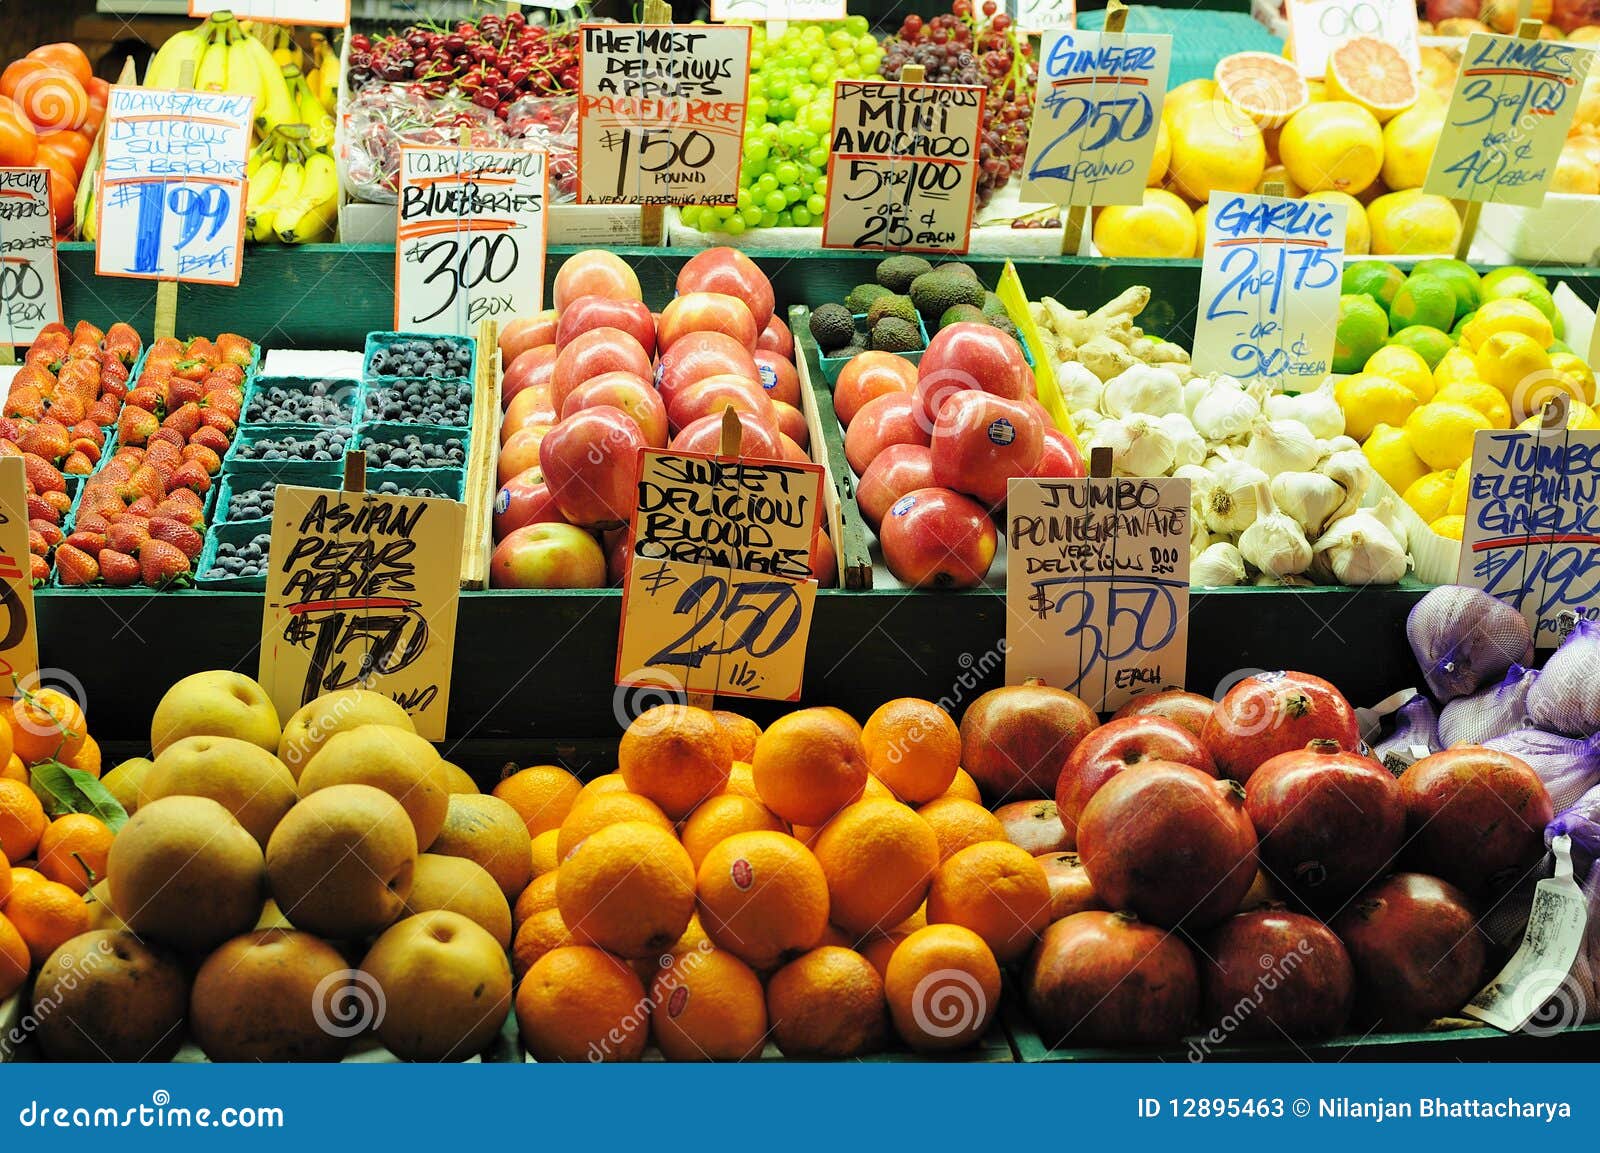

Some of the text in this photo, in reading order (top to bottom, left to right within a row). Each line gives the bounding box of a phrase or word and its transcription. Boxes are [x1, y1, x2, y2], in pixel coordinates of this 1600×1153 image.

[582, 28, 707, 54] THE MOST
[1046, 35, 1156, 77] GINGER
[1472, 38, 1576, 74] LIMES
[598, 78, 722, 98] APPLES
[836, 84, 977, 107] DELICIOUS
[1451, 79, 1498, 126] 3
[582, 95, 682, 122] PACIFIC
[858, 99, 948, 134] MINI
[126, 139, 212, 158] SWEET
[832, 127, 970, 157] AVOCADO
[654, 171, 706, 184] POUND
[843, 160, 884, 201] 5
[1074, 159, 1135, 179] POUND
[1443, 149, 1508, 188] 40
[853, 216, 914, 248] 25
[916, 231, 956, 244] EACH
[1214, 197, 1334, 237] GARLIC
[8, 302, 46, 326] BOX
[467, 294, 517, 325] BOX
[652, 456, 806, 494] SWEET
[1037, 480, 1161, 510] JUMBO
[299, 494, 428, 538] ASIAN
[645, 512, 774, 548] BLOOD
[1011, 506, 1188, 550] POMEGRANATE
[282, 536, 416, 573] PEAR
[634, 537, 813, 575] ORANGES
[1026, 554, 1145, 575] DELICIOUS
[1058, 543, 1106, 559] VERY
[282, 567, 416, 603] APPLES
[1114, 664, 1162, 689] EACH
